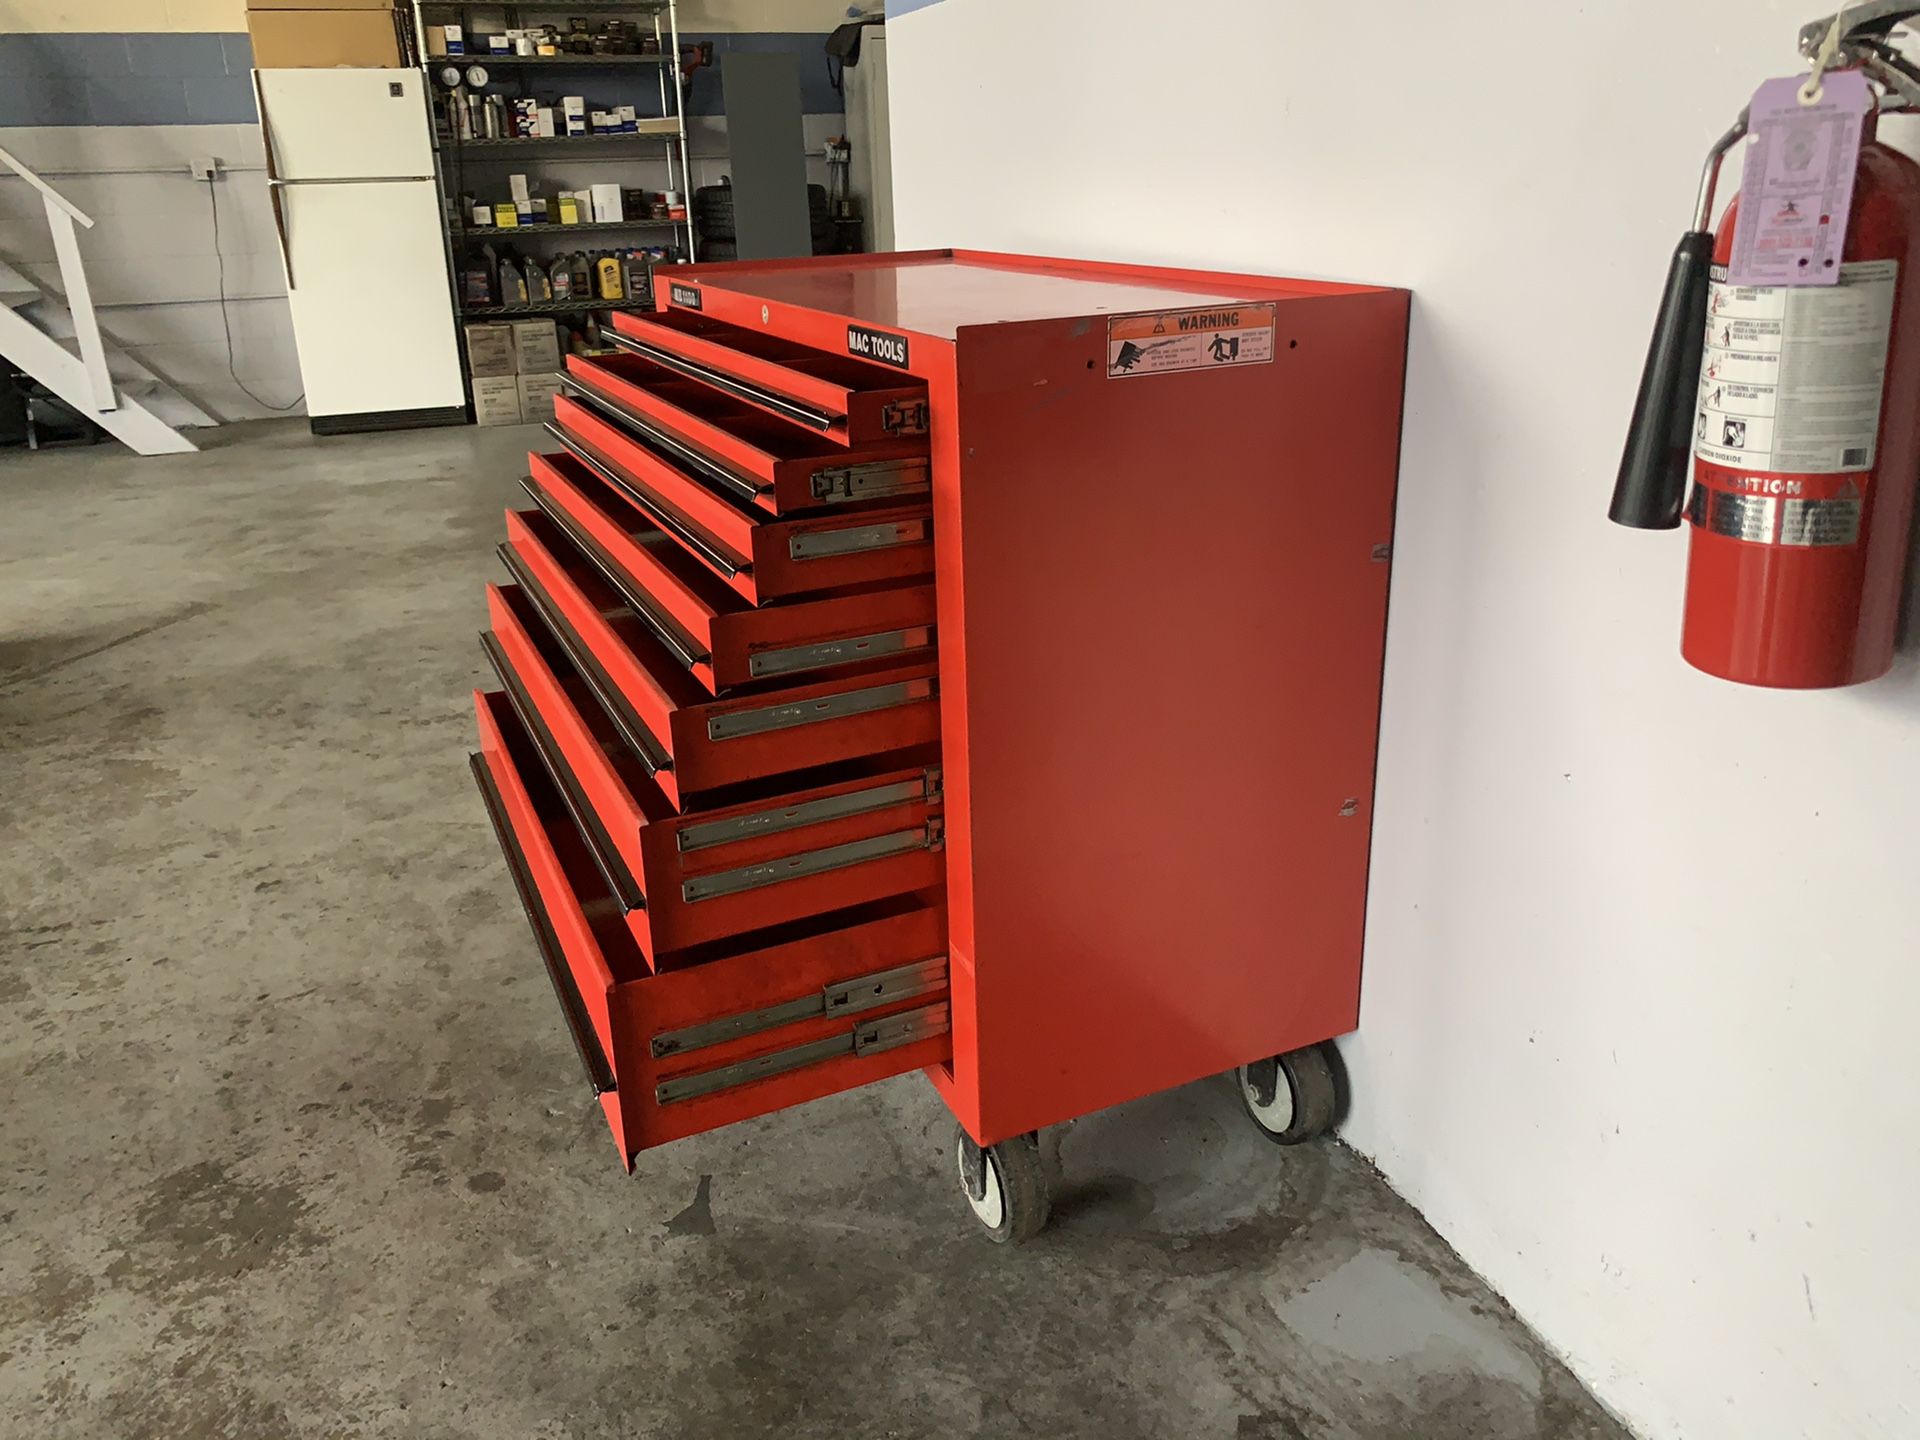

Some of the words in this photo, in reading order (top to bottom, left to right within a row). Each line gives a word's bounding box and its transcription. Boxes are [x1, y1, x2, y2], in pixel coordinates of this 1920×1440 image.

[1178, 311, 1240, 331] WARNING
[848, 330, 870, 353] MAC
[870, 336, 905, 363] TOOLS
[1715, 452, 1742, 464] DIOXIDE
